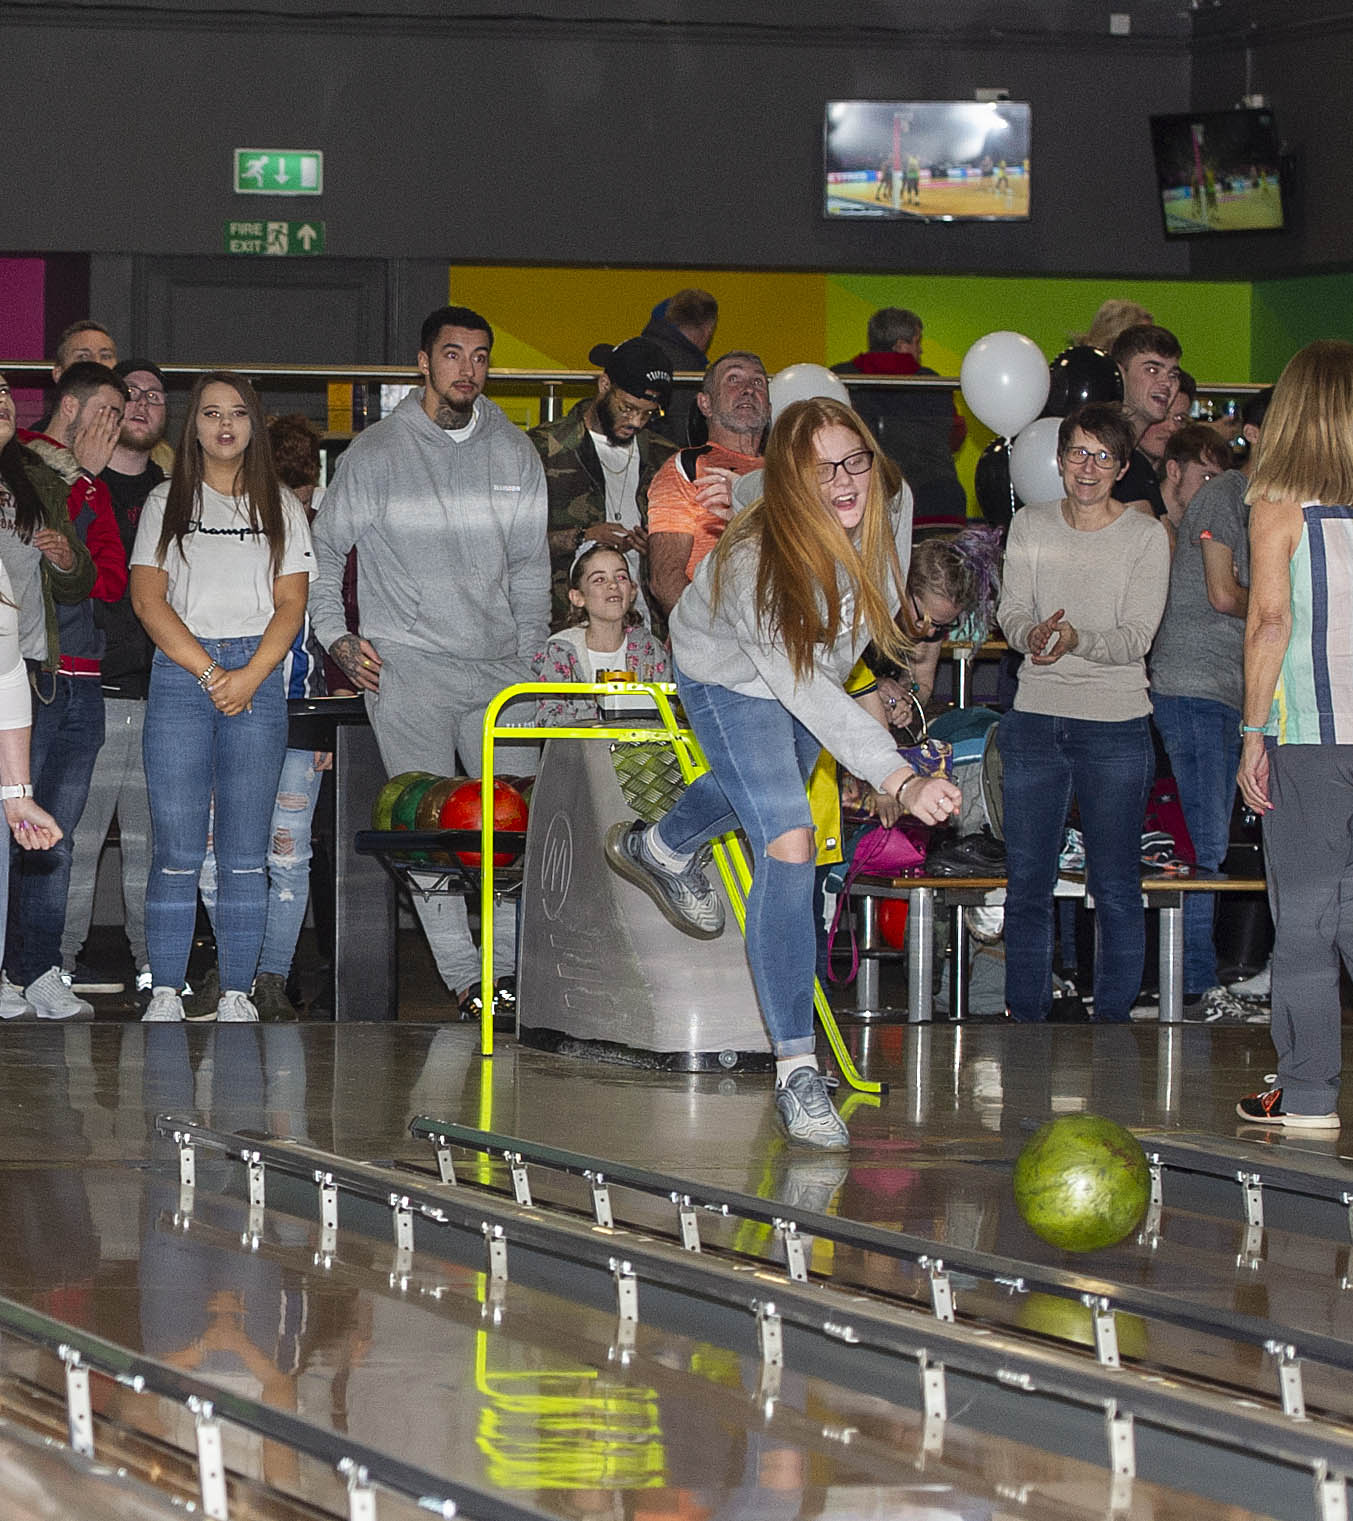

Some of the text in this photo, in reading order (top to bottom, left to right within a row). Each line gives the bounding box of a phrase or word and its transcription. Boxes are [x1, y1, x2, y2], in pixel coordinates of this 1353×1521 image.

[229, 222, 263, 236] FIRE
[229, 239, 261, 253] EXIT
[185, 520, 267, 541] hampi
